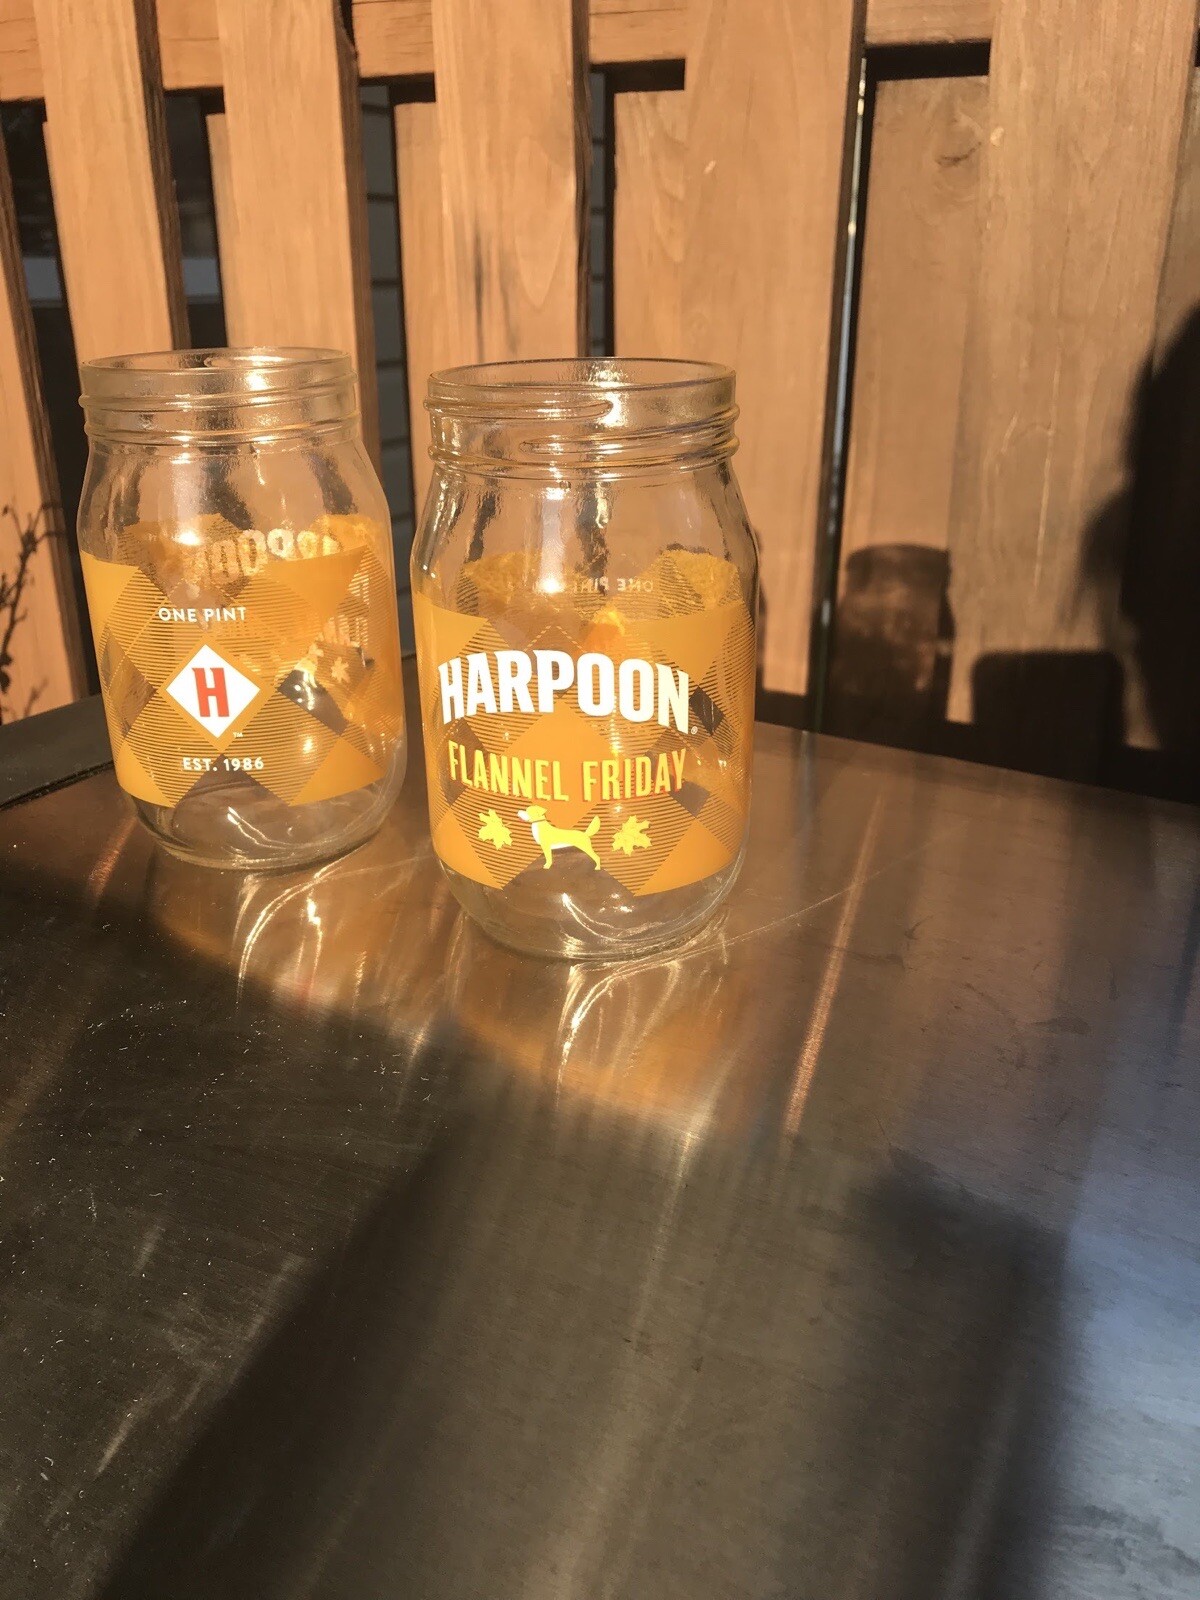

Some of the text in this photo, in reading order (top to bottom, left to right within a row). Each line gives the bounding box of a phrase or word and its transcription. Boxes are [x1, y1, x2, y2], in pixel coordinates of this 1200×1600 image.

[158, 606, 247, 623] ONE PINT
[191, 667, 230, 718] H
[438, 649, 689, 735] HARPOON
[182, 756, 265, 772] EST. 1986
[448, 739, 687, 802] FLANNEL FRIDAY
